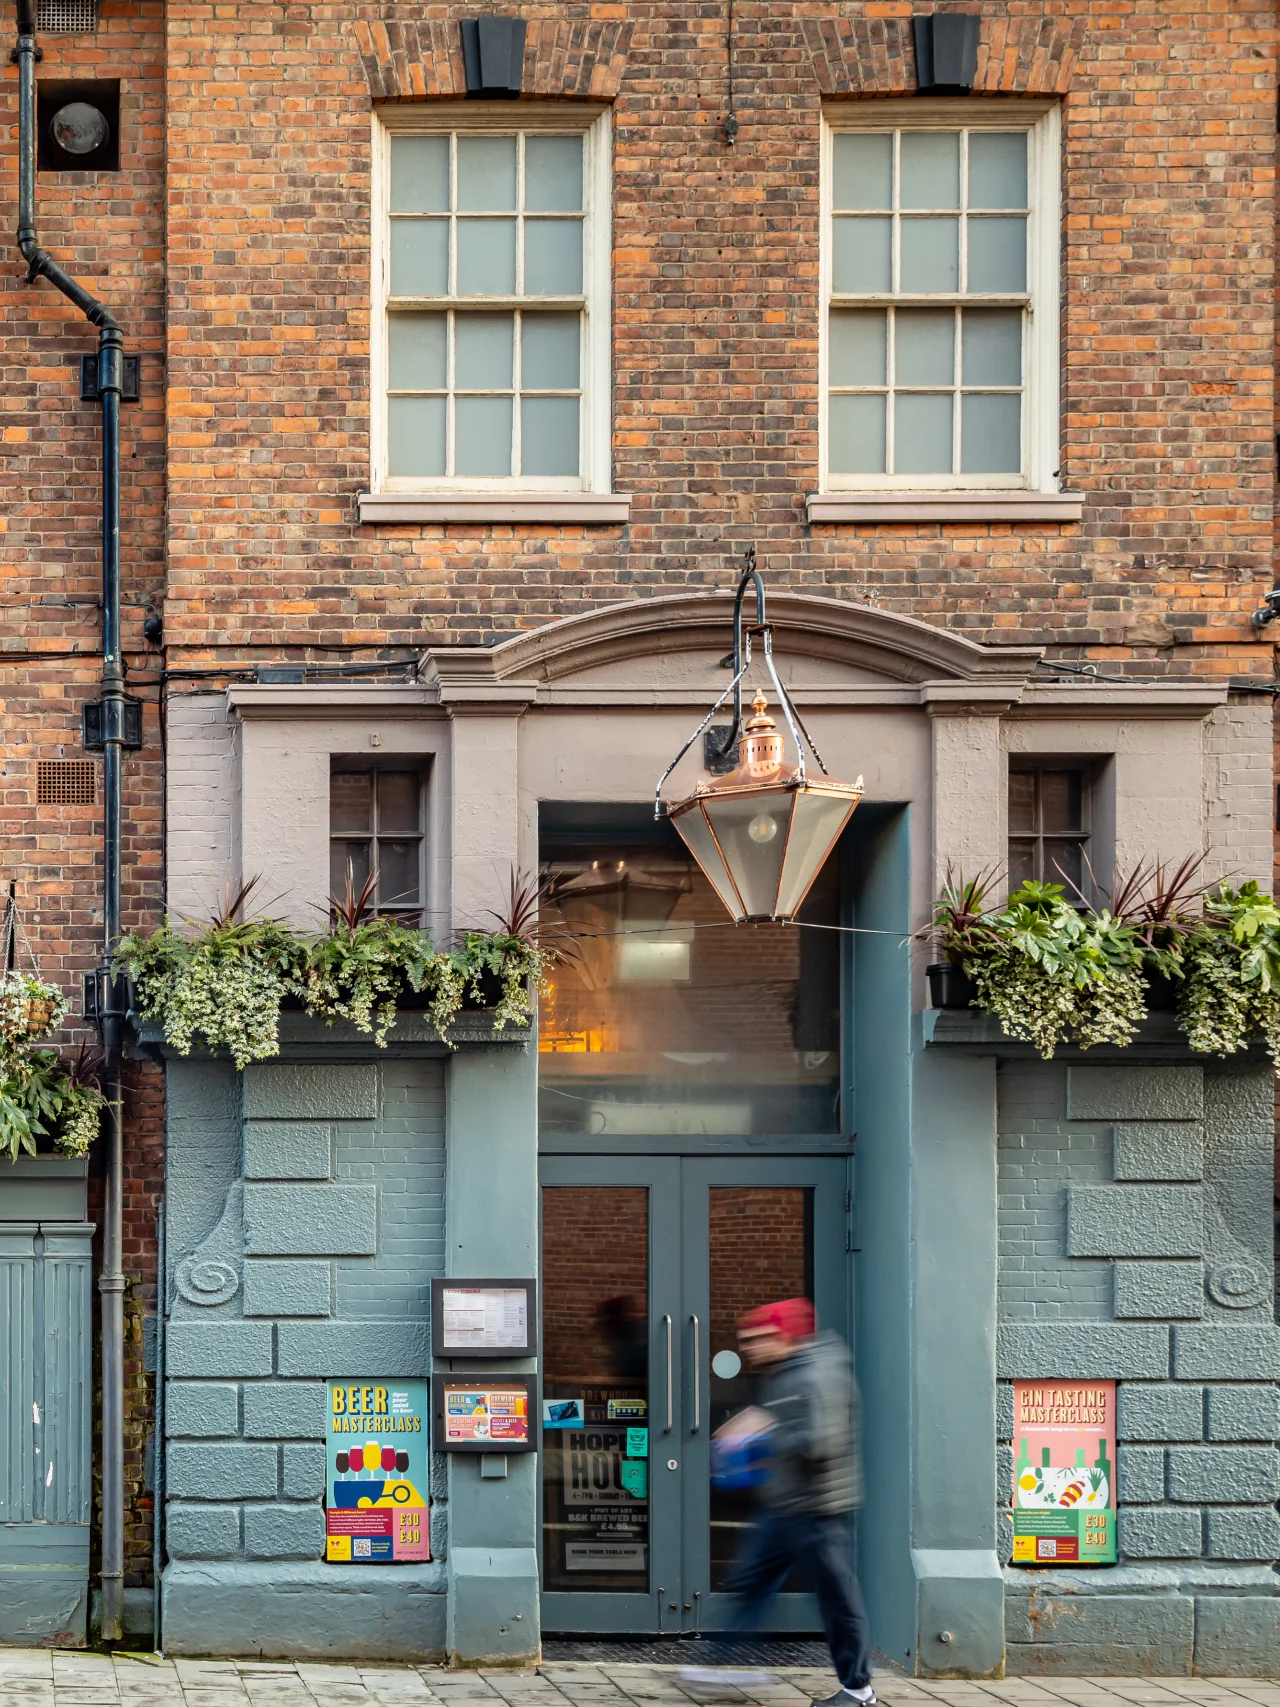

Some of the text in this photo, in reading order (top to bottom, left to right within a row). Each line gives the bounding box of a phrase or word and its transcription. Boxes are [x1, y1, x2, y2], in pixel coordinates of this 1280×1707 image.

[332, 1386, 389, 1415] BEER
[1020, 1390, 1106, 1408] GIN TASTING
[1020, 1408, 1106, 1424] MASTERCLASS
[331, 1416, 421, 1433] MASTERCLASS
[400, 1513, 419, 1526] £30
[568, 1514, 588, 1522] B&K
[590, 1514, 630, 1522] BREWED
[1086, 1514, 1106, 1528] £30
[400, 1529, 420, 1543] £40
[1086, 1531, 1106, 1545] £40
